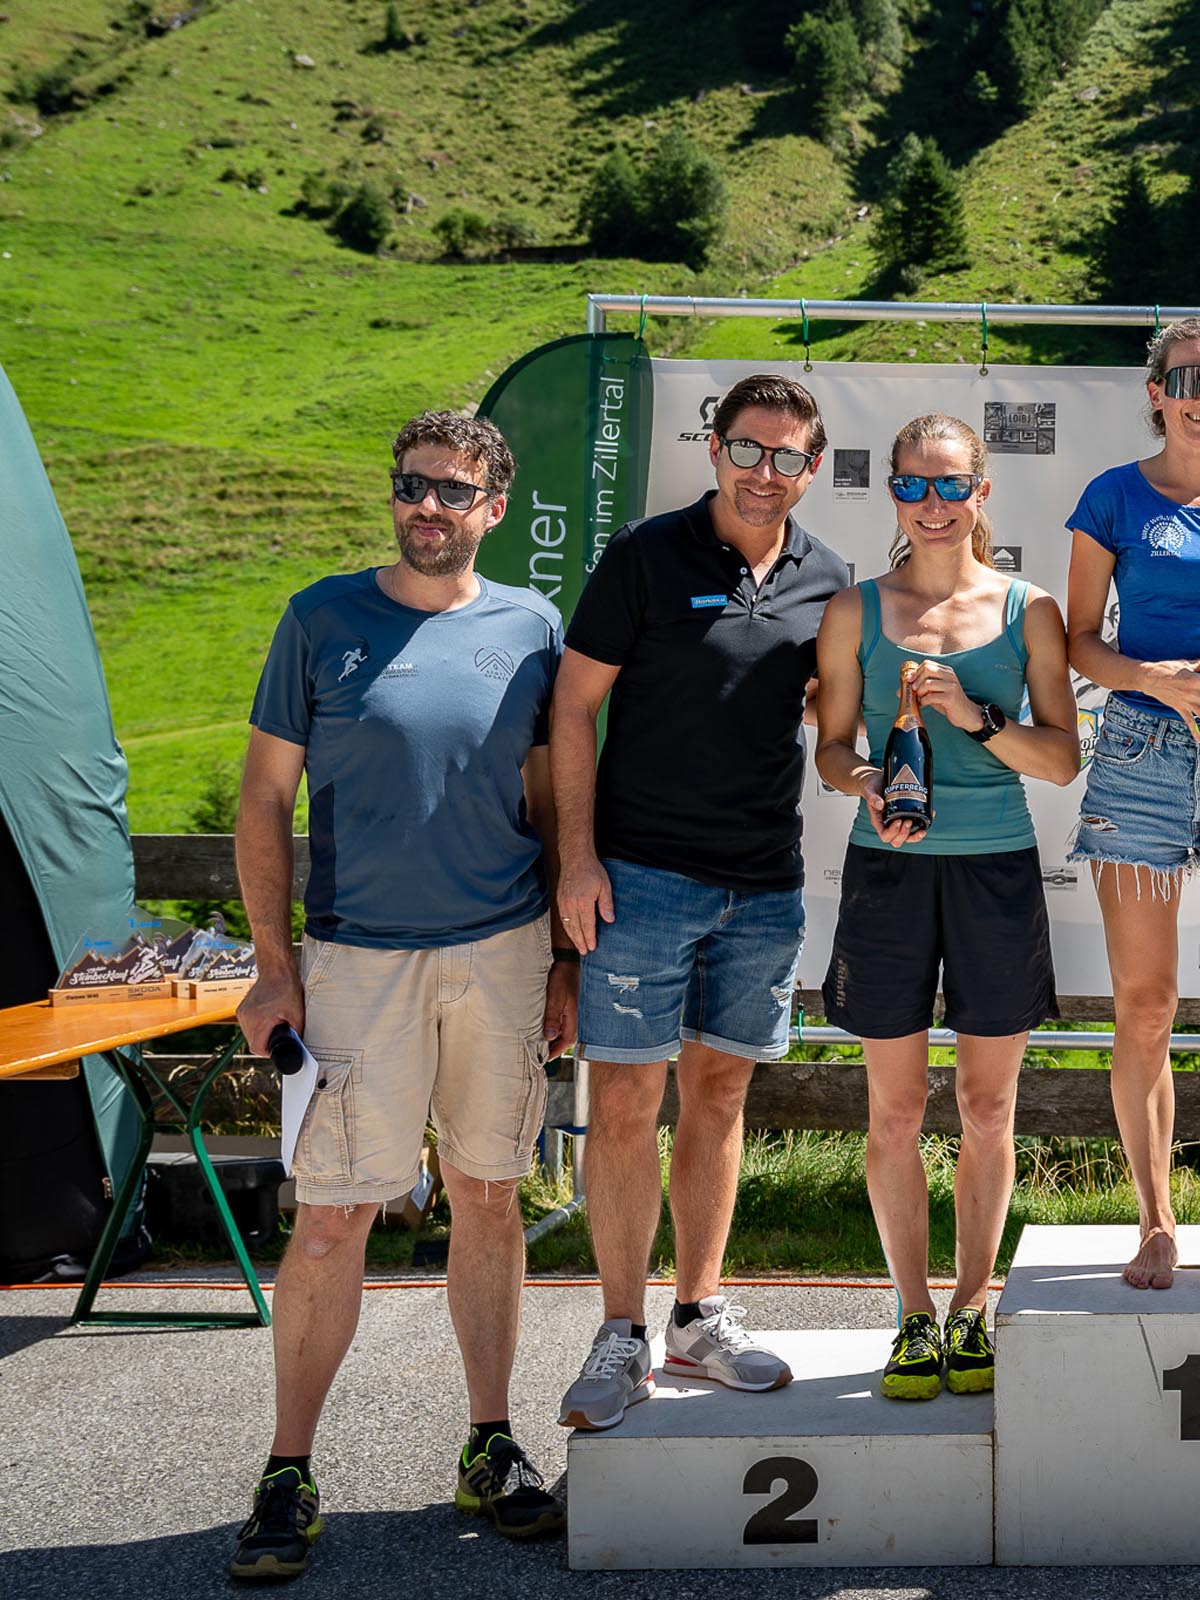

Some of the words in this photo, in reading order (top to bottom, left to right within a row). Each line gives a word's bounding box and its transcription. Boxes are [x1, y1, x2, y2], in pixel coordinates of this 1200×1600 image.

[592, 377, 625, 480] Zillertal
[589, 490, 614, 523] im
[742, 1456, 820, 1546] 2
